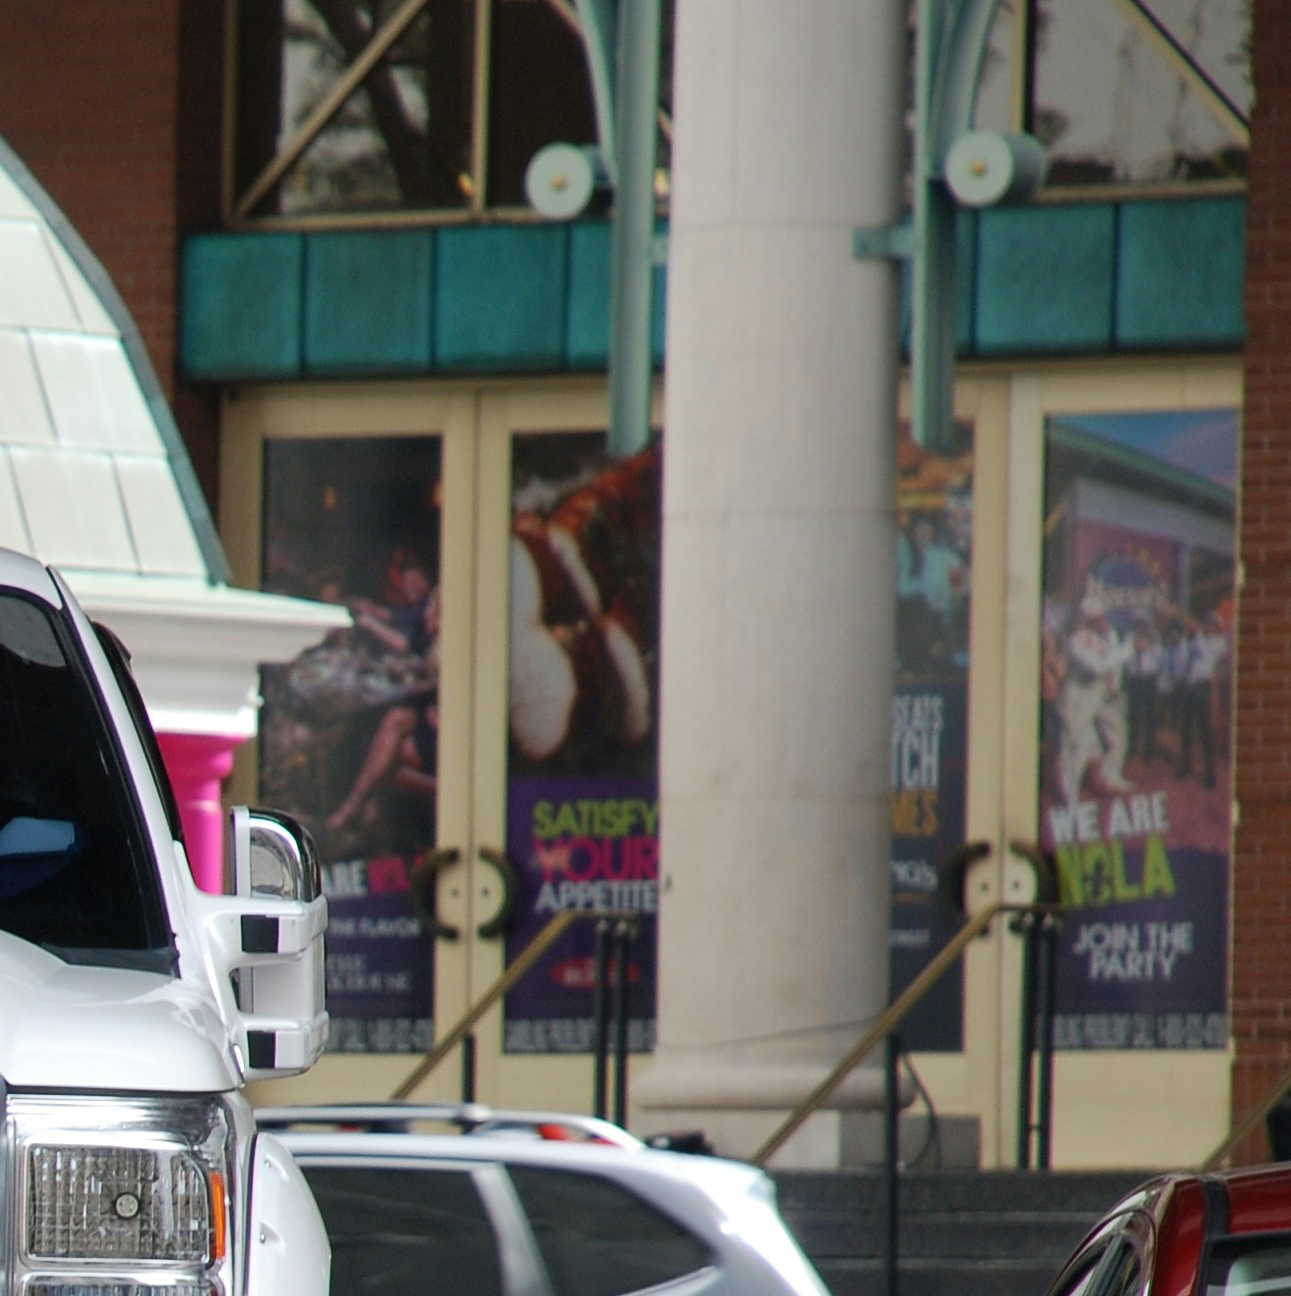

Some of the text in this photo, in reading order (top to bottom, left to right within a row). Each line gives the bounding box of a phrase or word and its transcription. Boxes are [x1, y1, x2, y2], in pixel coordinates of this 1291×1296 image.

[533, 801, 659, 838] SATISFY
[1050, 791, 1168, 844] WE ARE
[533, 837, 660, 881] YOUR
[534, 880, 658, 913] APPETITE
[1074, 921, 1194, 955] JOIN THE
[1089, 950, 1178, 981] PARTY
